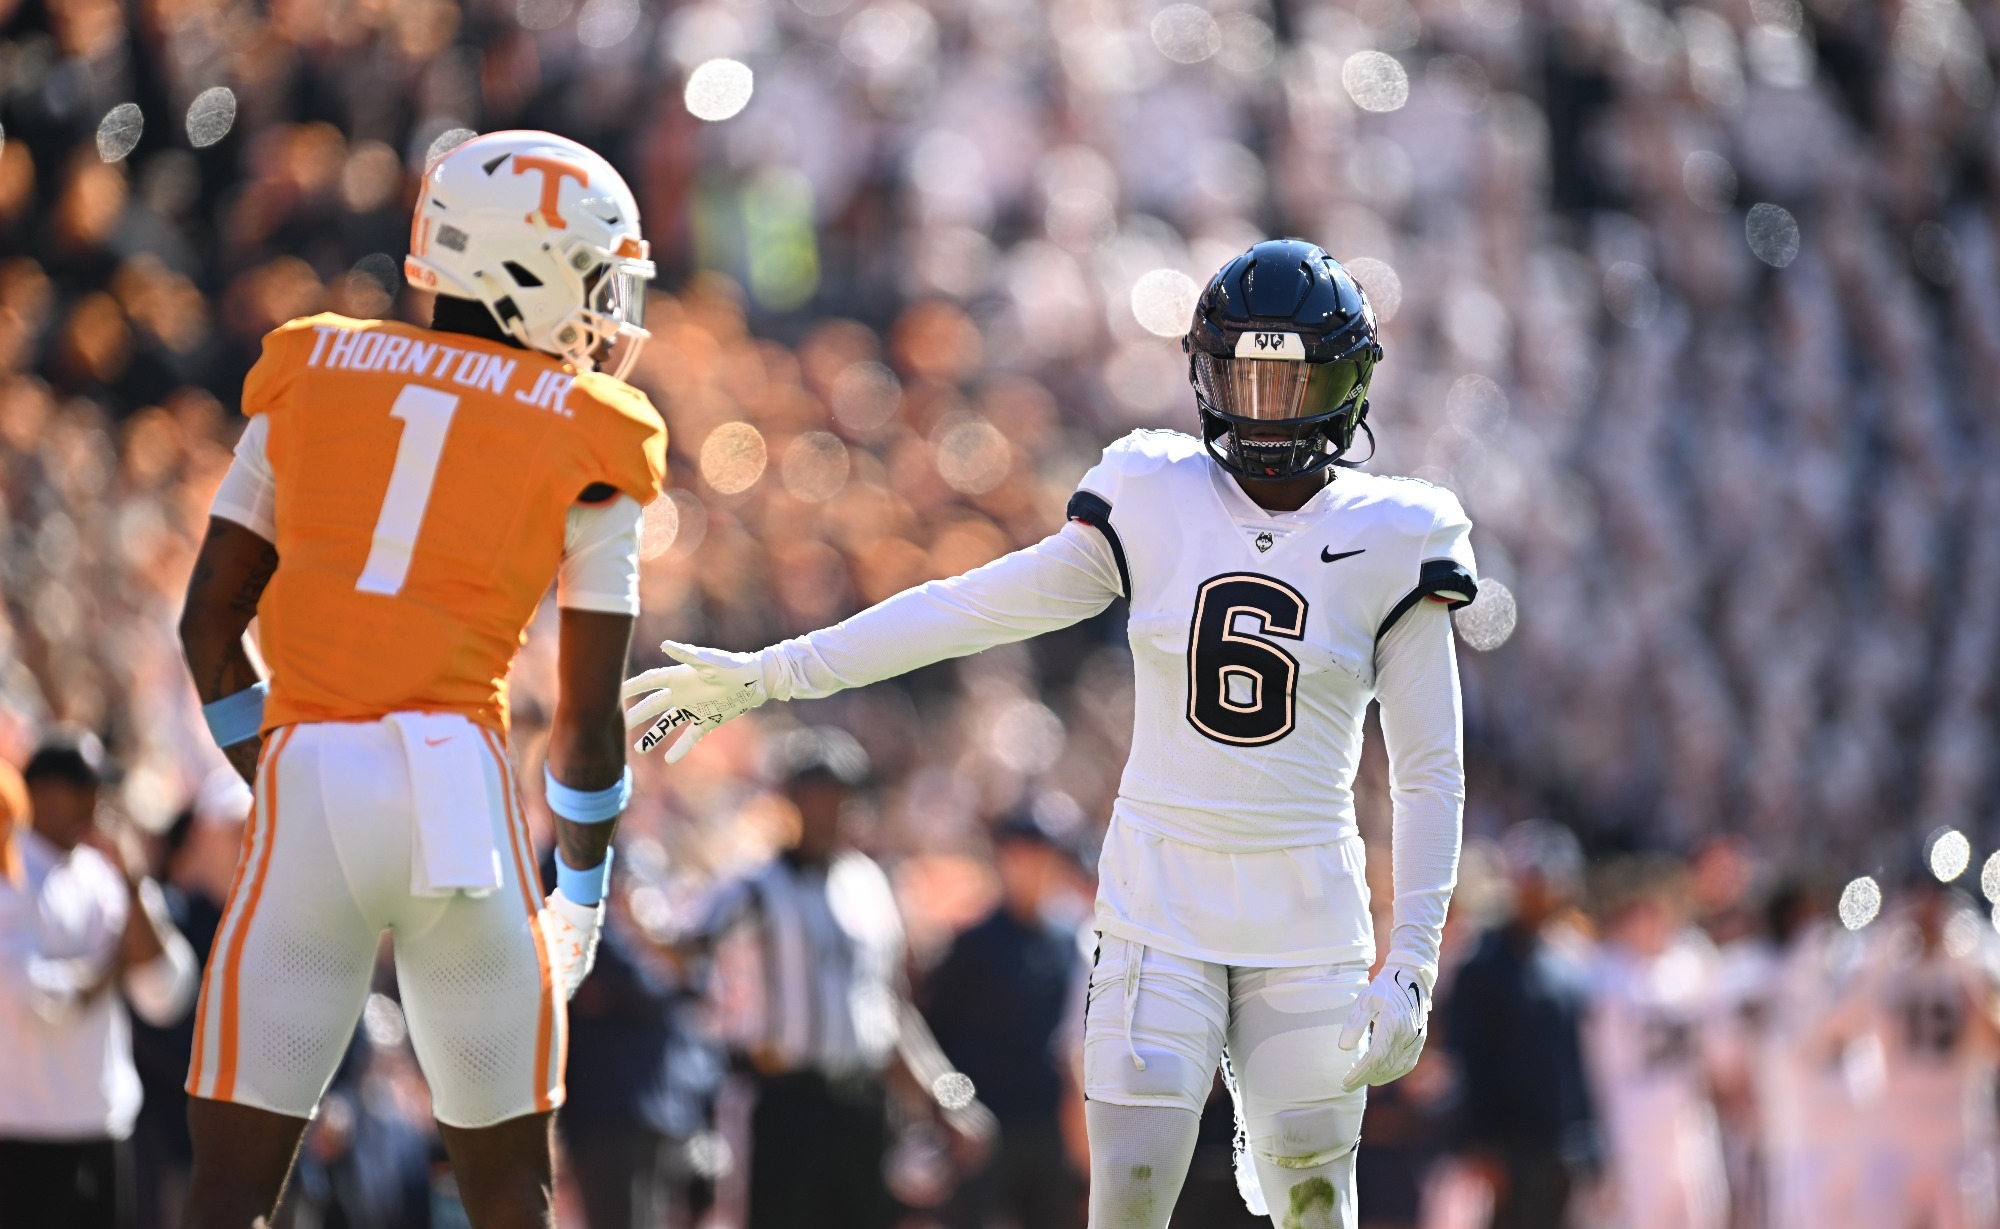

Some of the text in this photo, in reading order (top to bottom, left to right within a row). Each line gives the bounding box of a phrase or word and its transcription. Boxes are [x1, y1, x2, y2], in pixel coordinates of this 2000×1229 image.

[512, 154, 589, 230] T
[307, 324, 576, 418] THORNTON JR.
[354, 382, 460, 596] 1
[1186, 571, 1309, 747] 6
[641, 708, 700, 751] ALPHA
